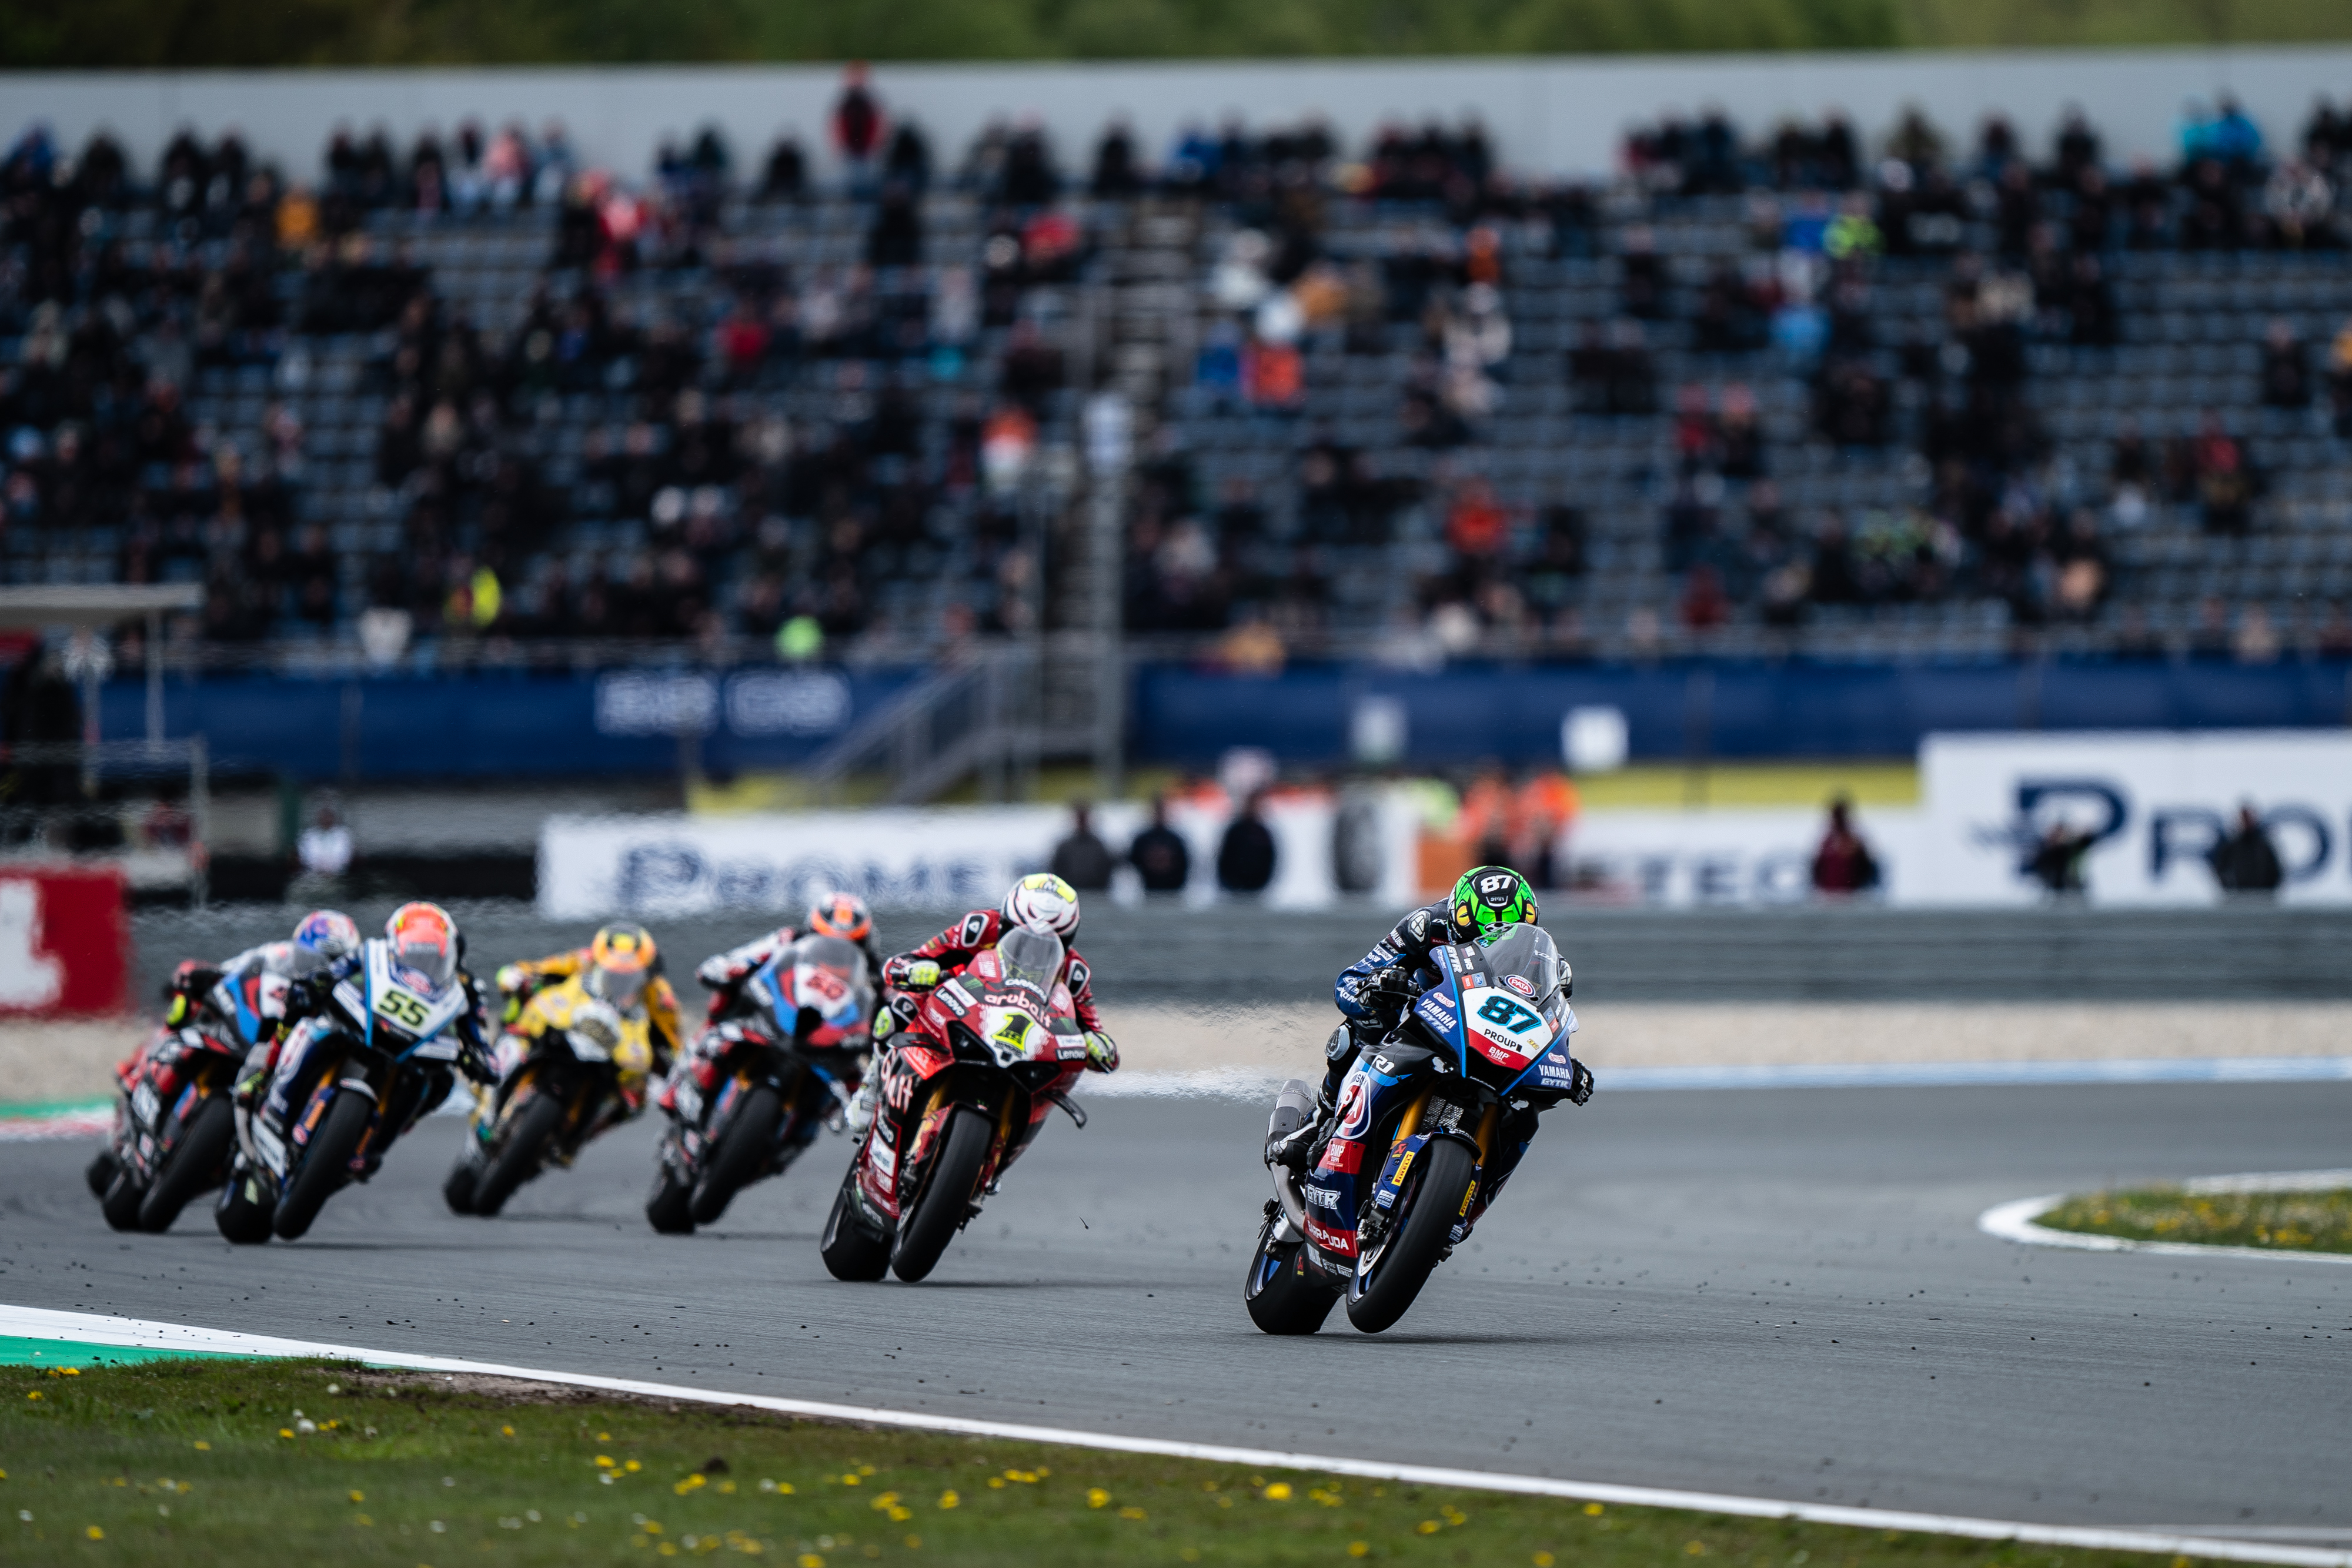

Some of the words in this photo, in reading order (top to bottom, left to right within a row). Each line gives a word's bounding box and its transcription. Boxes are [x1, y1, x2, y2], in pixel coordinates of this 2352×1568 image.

[1481, 875, 1512, 894] 87
[1446, 945, 1463, 973] GYTR
[1511, 979, 1529, 992] PATA
[379, 989, 430, 1028] 55
[936, 988, 965, 1016] Lenovo
[1421, 998, 1457, 1029] YAMAHA
[1418, 1010, 1451, 1034] GYTR
[1477, 996, 1542, 1035] 87
[991, 1012, 1035, 1052] 1
[1058, 1049, 1086, 1060] Lenovo
[1488, 1046, 1509, 1059] BMP
[1538, 1064, 1571, 1079] YAMAHA
[1541, 1078, 1569, 1088] GYTR
[1330, 1144, 1344, 1158] BMP
[1307, 1183, 1339, 1209] GYTR
